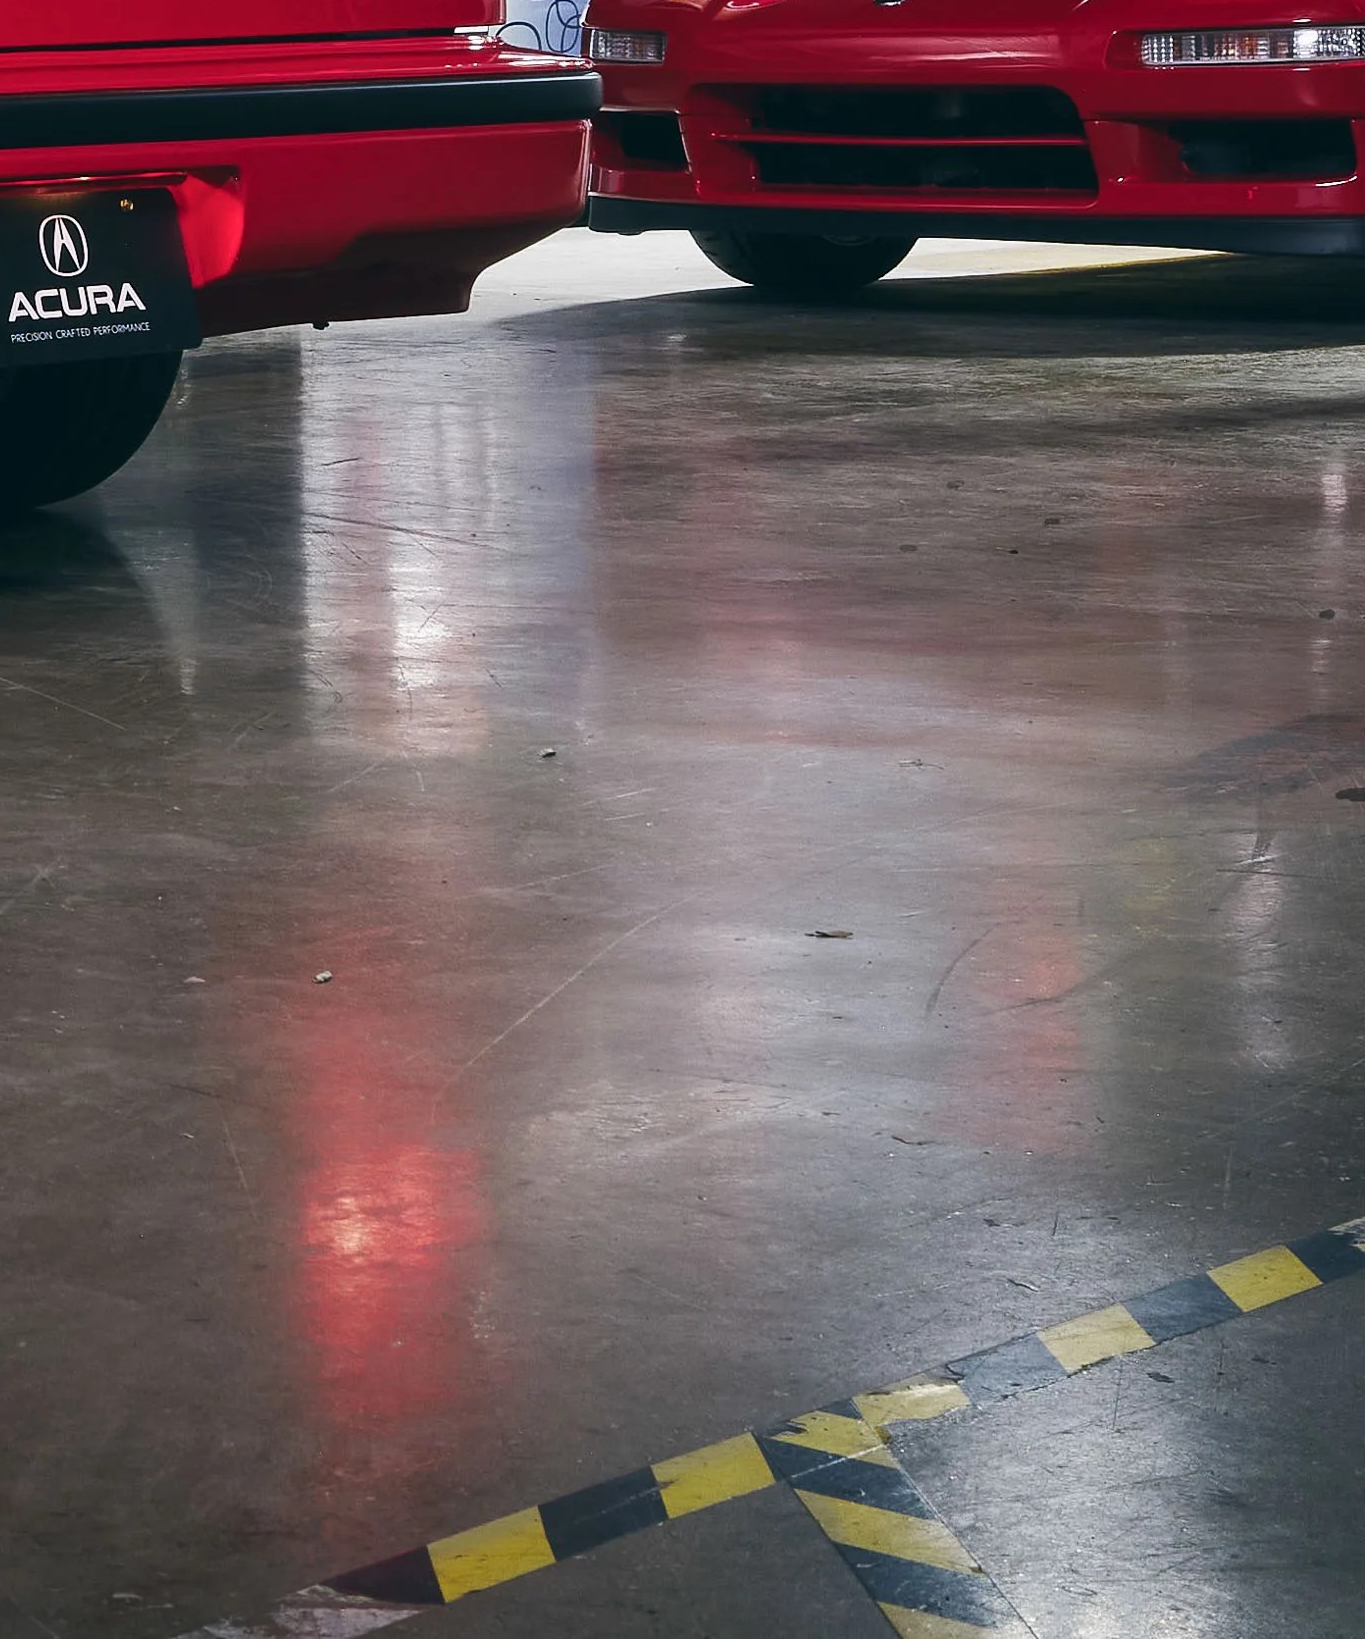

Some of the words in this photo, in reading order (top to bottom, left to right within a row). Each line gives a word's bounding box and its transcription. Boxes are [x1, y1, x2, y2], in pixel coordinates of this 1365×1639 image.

[8, 282, 146, 323] ACURA
[10, 330, 53, 344] PRECISION
[55, 326, 91, 340] CRAFTED
[93, 321, 151, 336] PERFORMANCE
